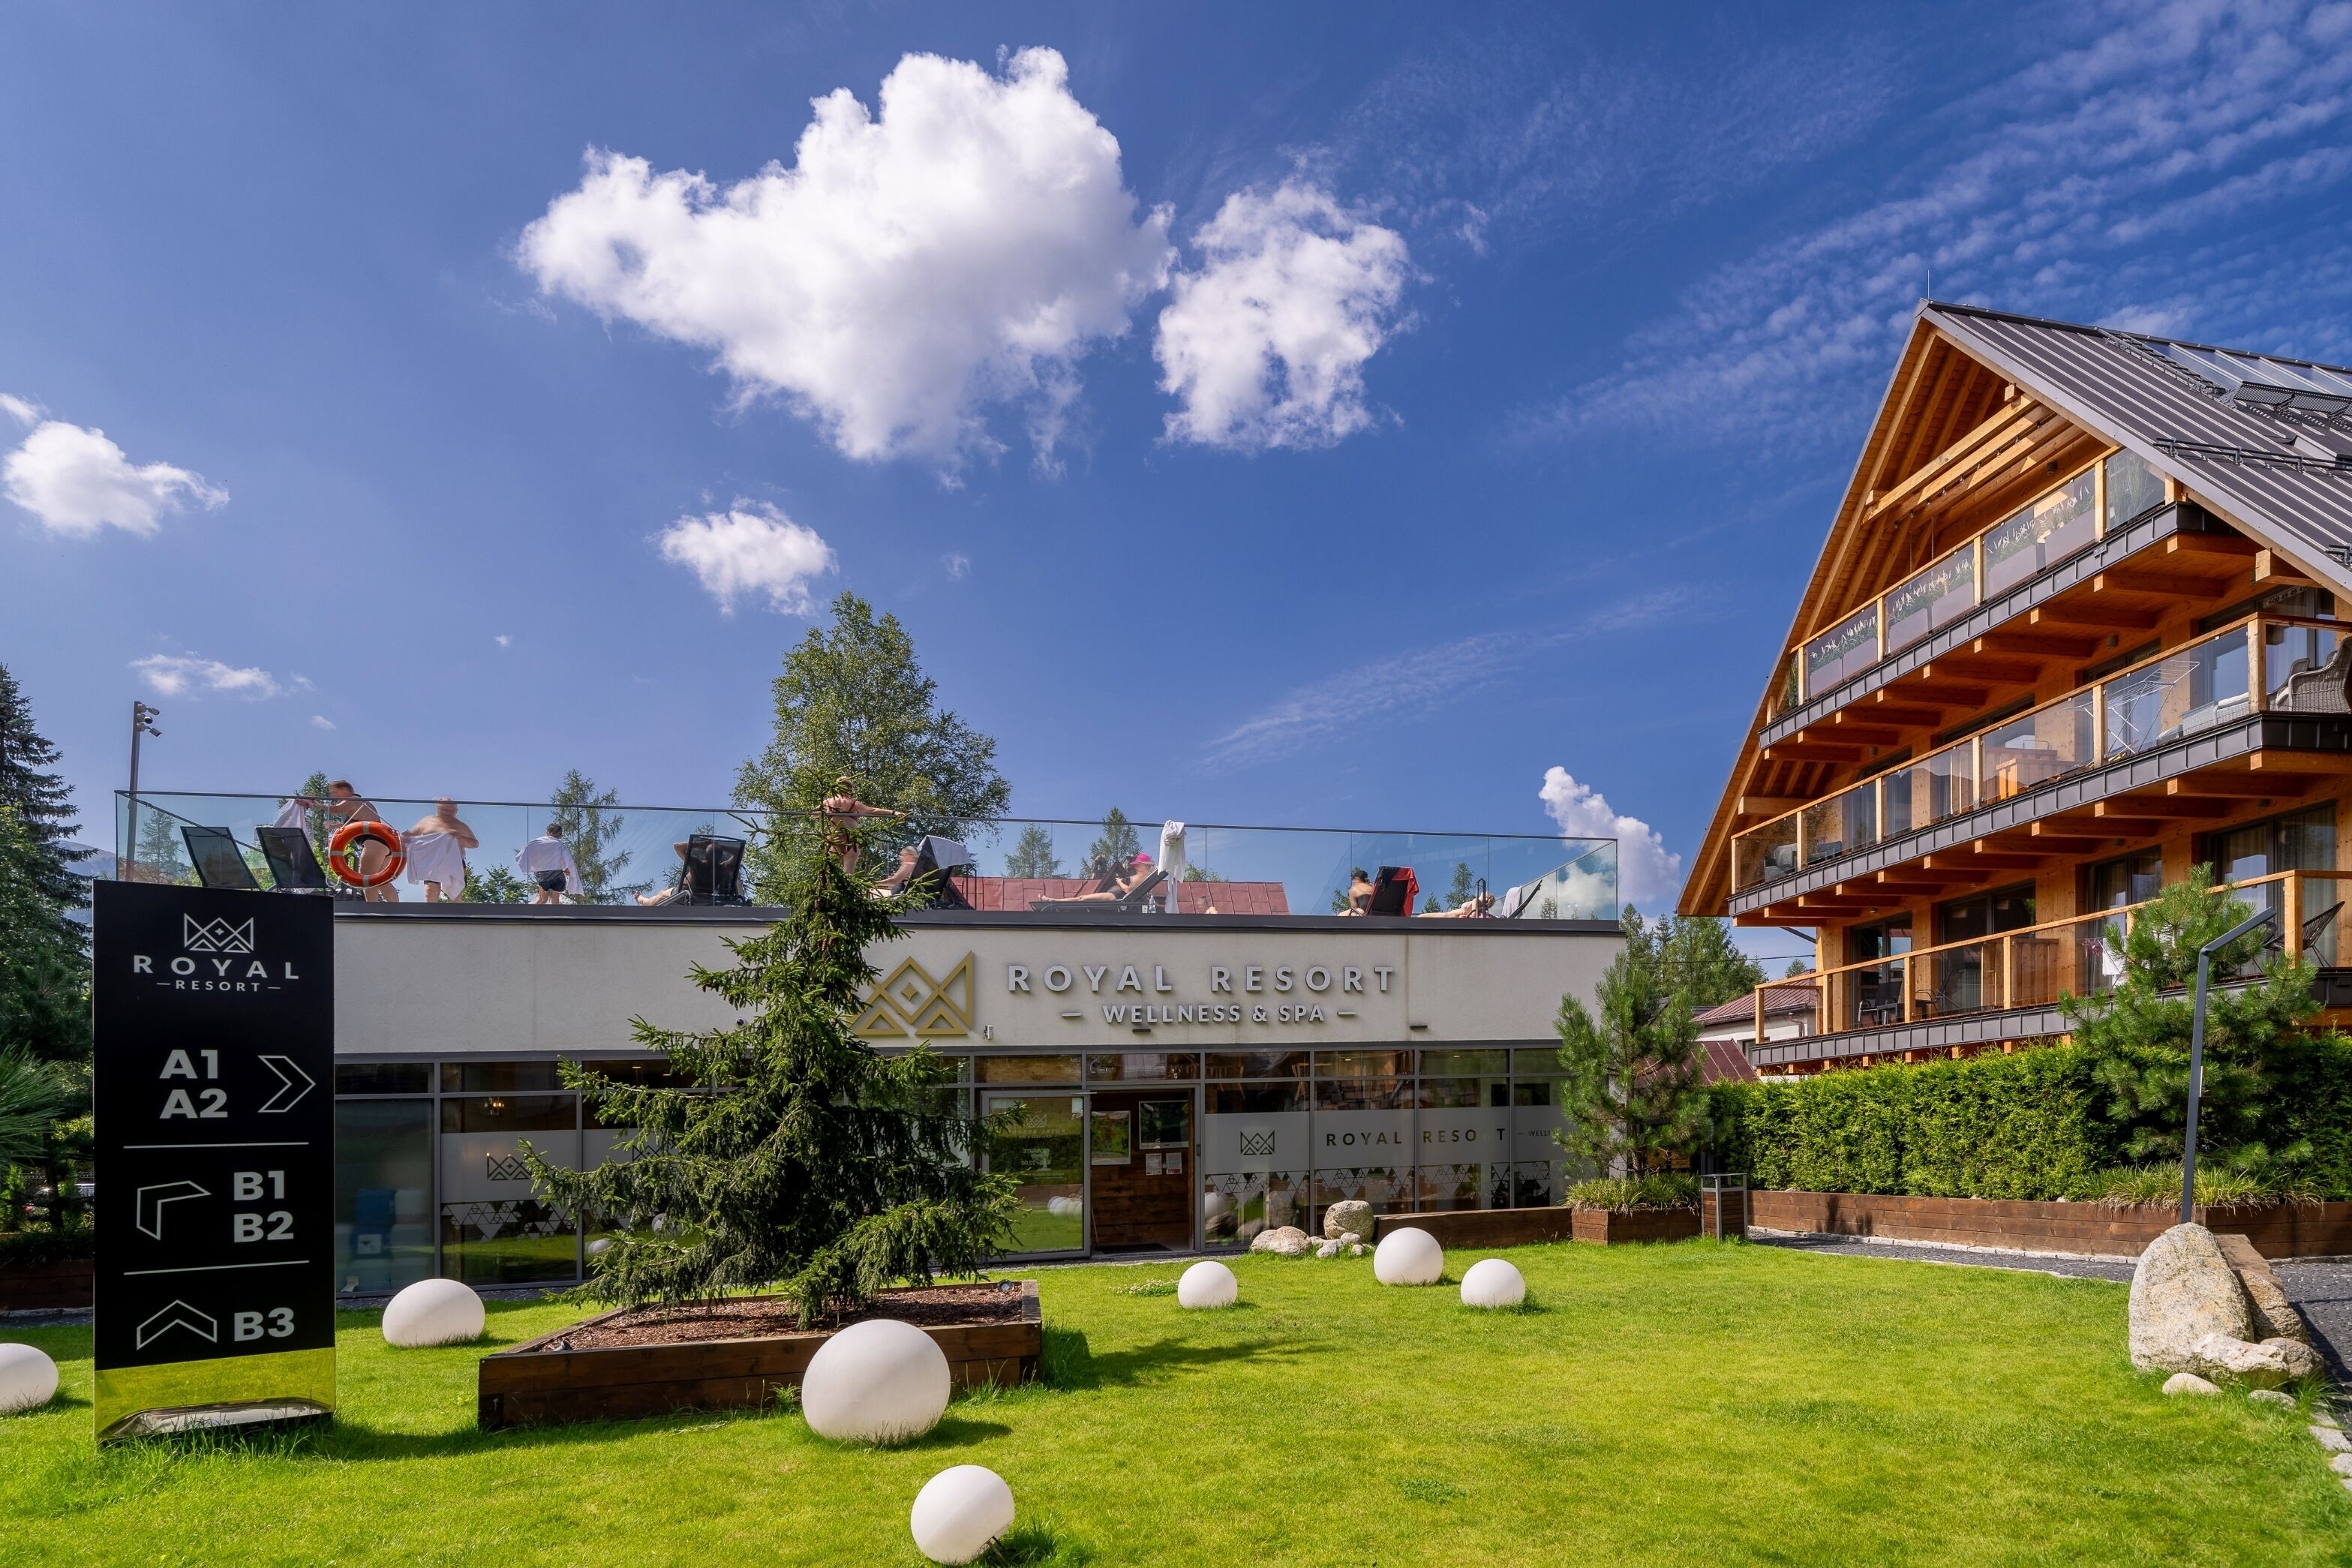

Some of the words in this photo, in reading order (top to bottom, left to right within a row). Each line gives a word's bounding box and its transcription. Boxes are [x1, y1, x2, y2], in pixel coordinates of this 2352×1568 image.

[133, 954, 299, 980] ROYAL
[1008, 966, 1172, 992] ROYAL
[1212, 966, 1393, 992] RESORT
[175, 980, 260, 992] RESORT
[1103, 1005, 1240, 1023] WELLNESS
[1253, 1005, 1267, 1023] &
[1278, 1005, 1323, 1022] SPA
[159, 1050, 218, 1079] A1
[160, 1089, 228, 1119] A2
[1326, 1131, 1402, 1146] ROYAL
[1423, 1128, 1506, 1143] RESOT
[233, 1170, 284, 1200] B1
[233, 1211, 294, 1242] B2
[233, 1308, 295, 1341] B3
